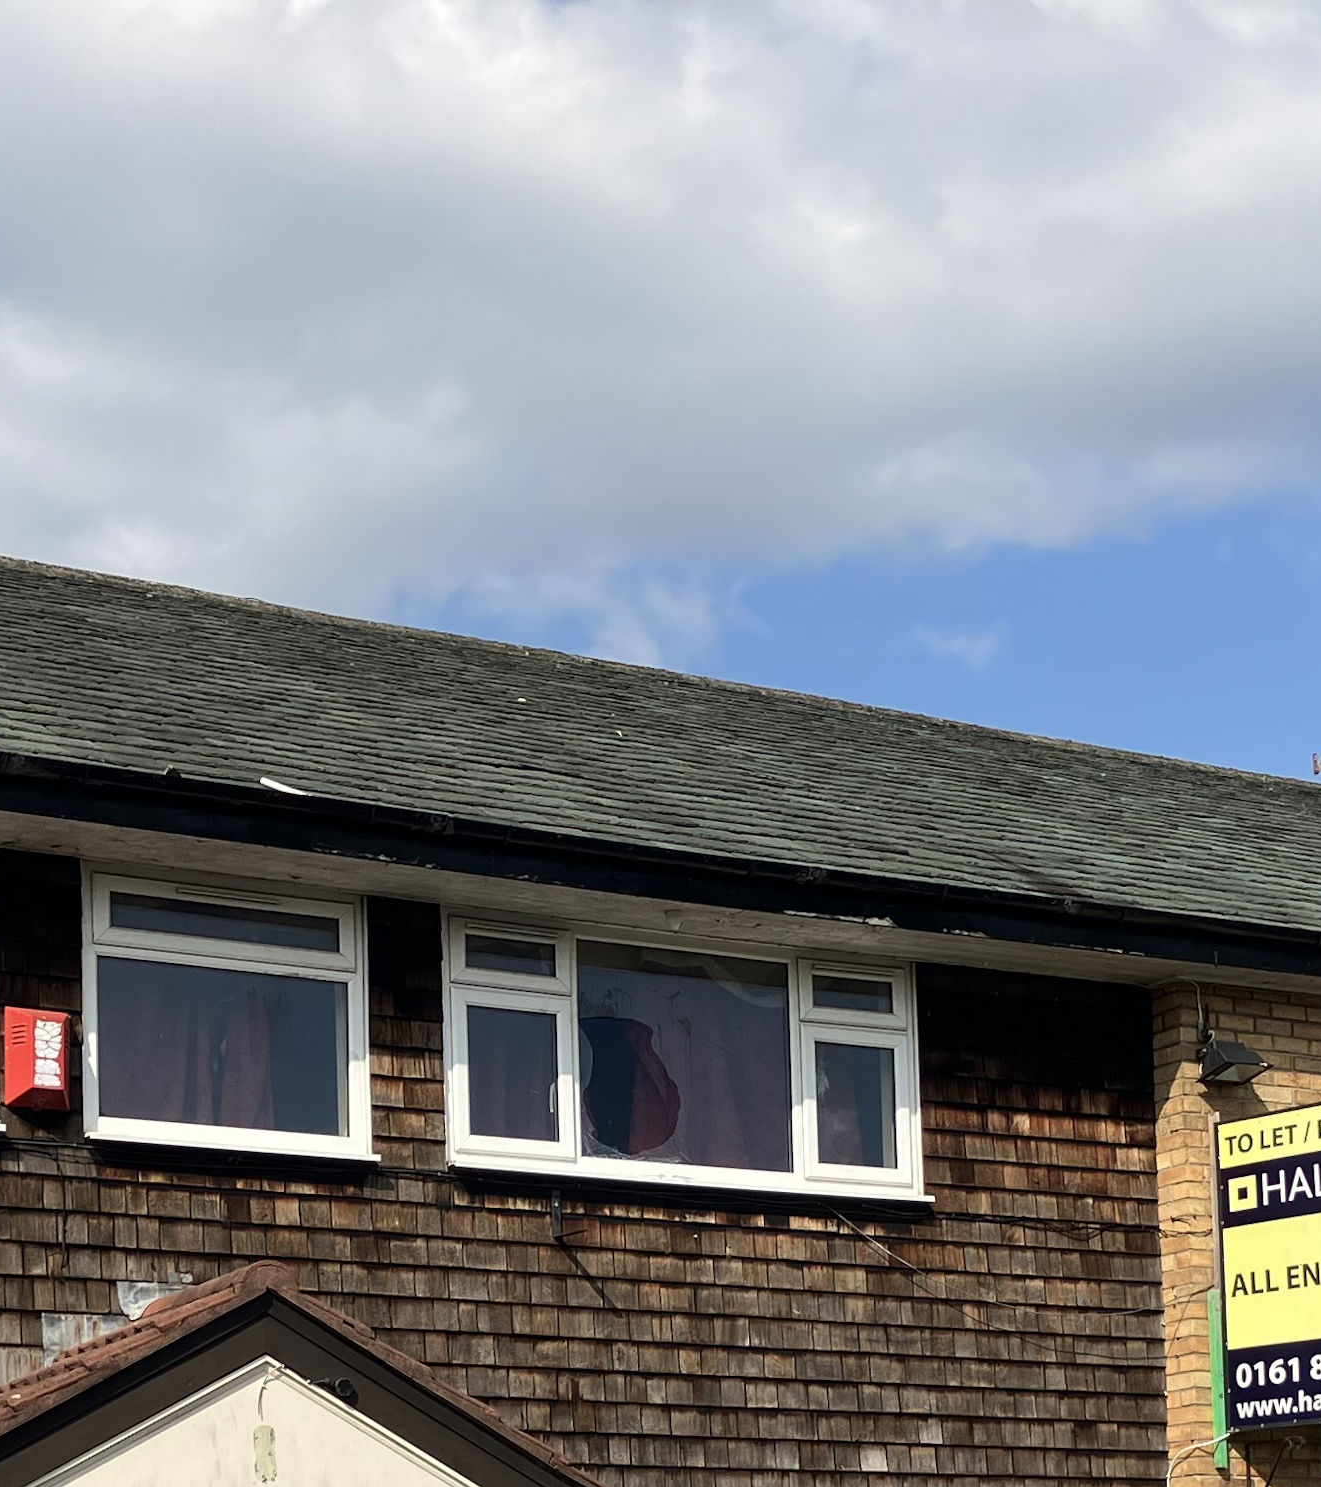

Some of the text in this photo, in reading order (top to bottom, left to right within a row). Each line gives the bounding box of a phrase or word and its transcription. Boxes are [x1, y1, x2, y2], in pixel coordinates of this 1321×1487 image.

[1225, 1133, 1253, 1156] TO
[1260, 1124, 1297, 1149] LET
[1231, 1269, 1280, 1298] ALL
[1235, 1356, 1300, 1388] 0161
